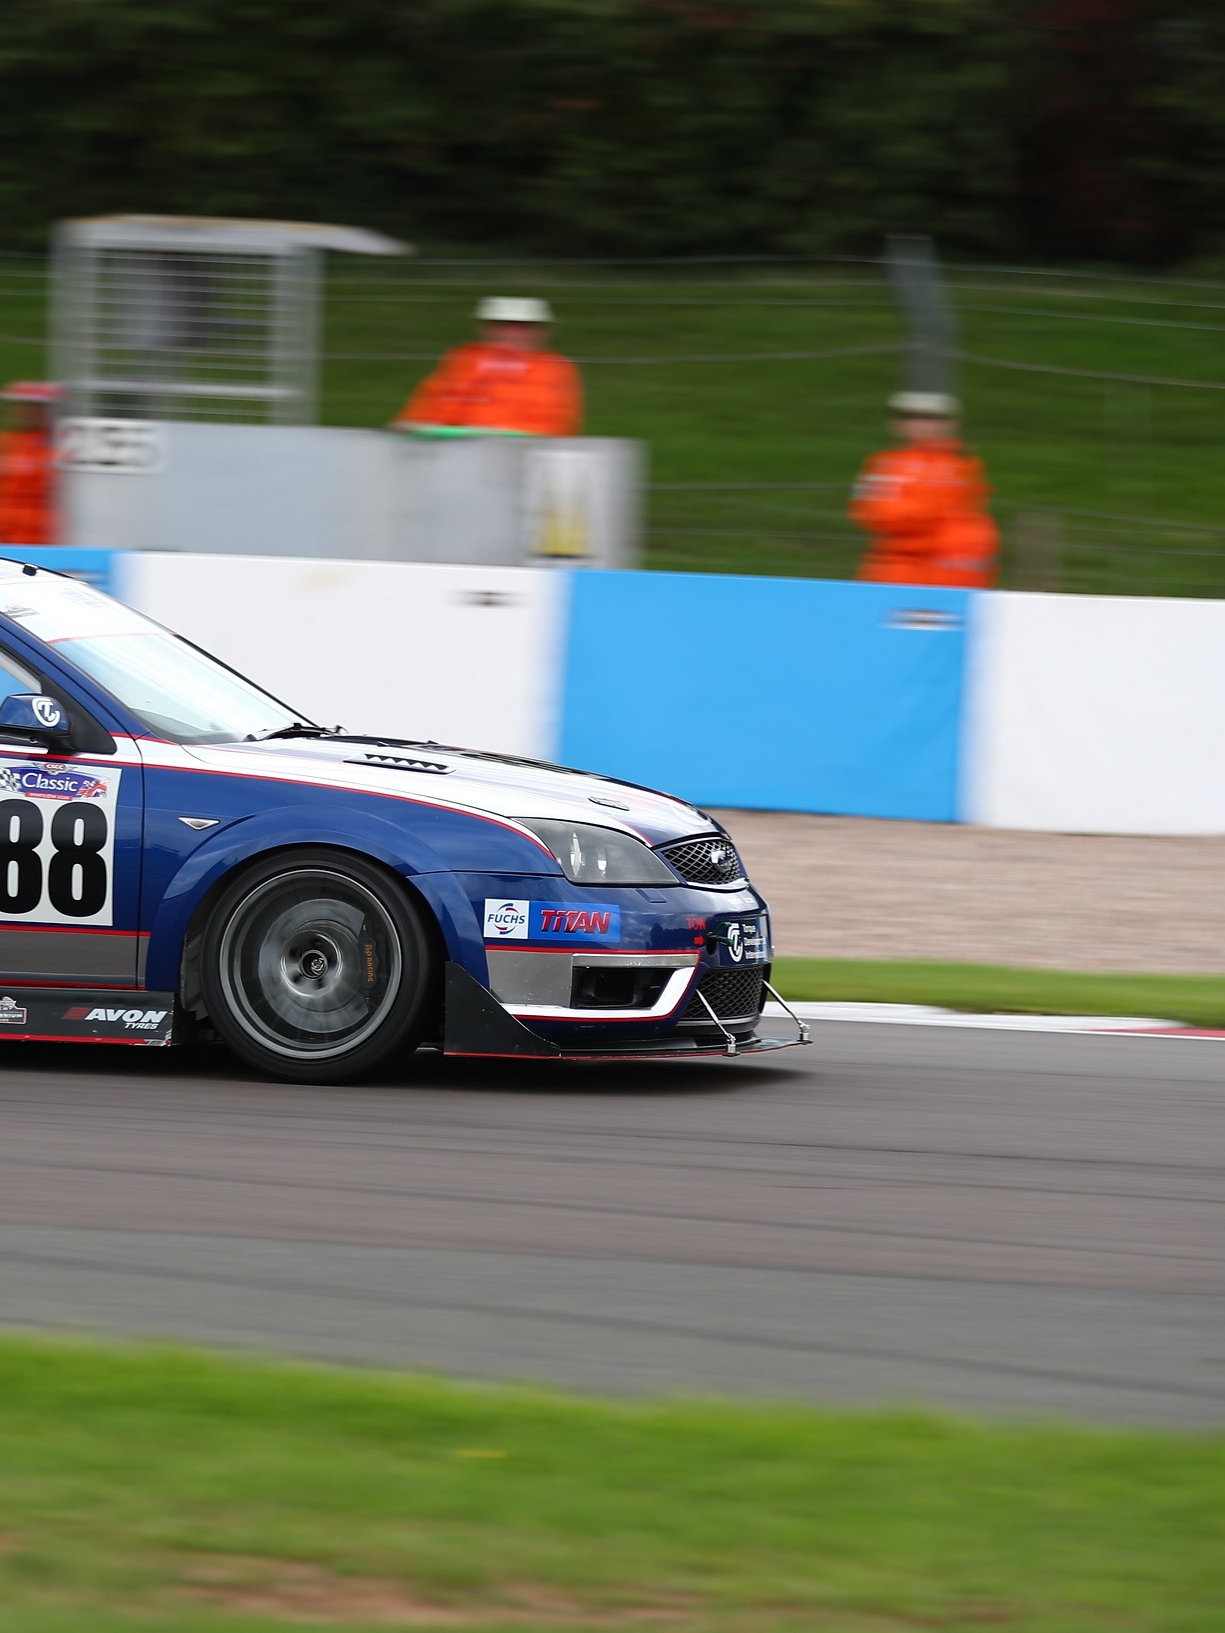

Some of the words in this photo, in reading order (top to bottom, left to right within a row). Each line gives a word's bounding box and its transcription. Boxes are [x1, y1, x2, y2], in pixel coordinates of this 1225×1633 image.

[22, 772, 79, 792] Classic
[487, 913, 526, 925] FUCHS
[540, 909, 611, 934] TITAN
[84, 1008, 168, 1023] AVON
[124, 1022, 159, 1030] TYRES
